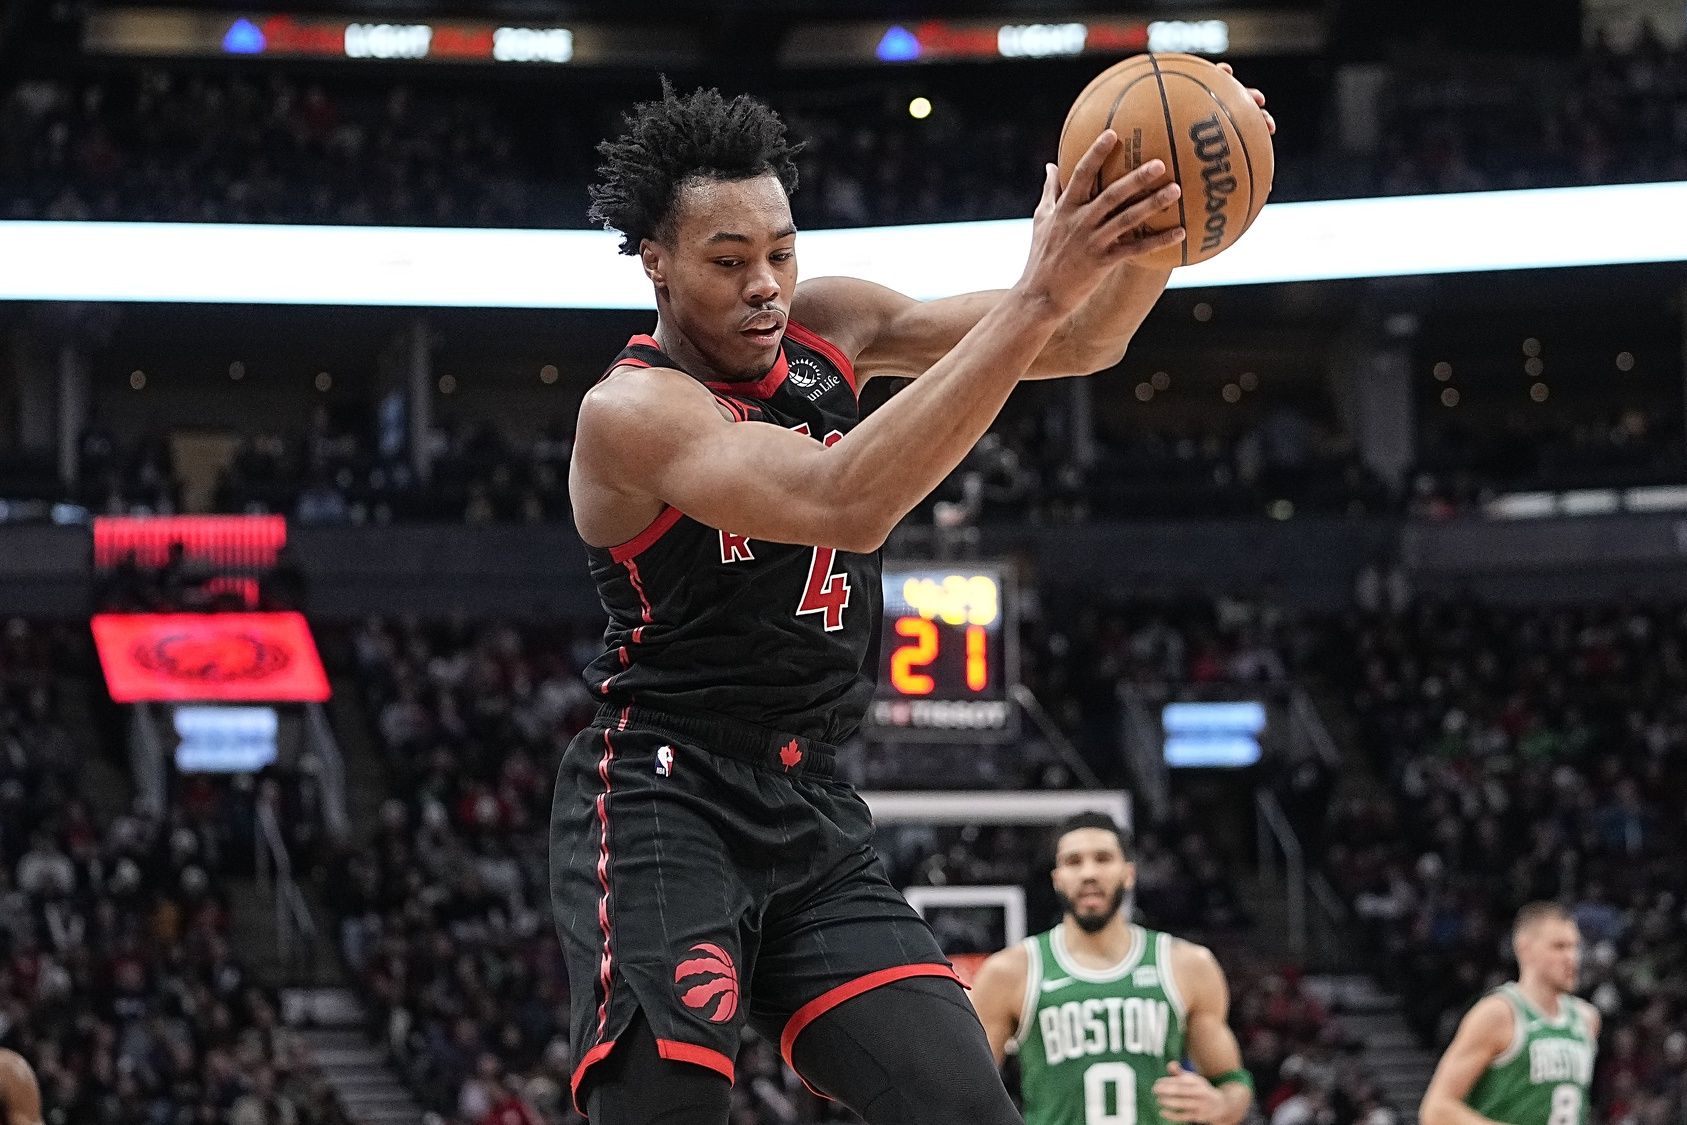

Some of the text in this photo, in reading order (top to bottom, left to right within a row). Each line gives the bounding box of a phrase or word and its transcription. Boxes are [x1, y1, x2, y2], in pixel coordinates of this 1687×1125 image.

[1189, 111, 1237, 252] Wilson
[818, 374, 841, 393] Life
[796, 545, 851, 632] 4
[890, 615, 988, 695] 21
[1038, 997, 1170, 1066] BOSTON
[1083, 1061, 1138, 1125] 0
